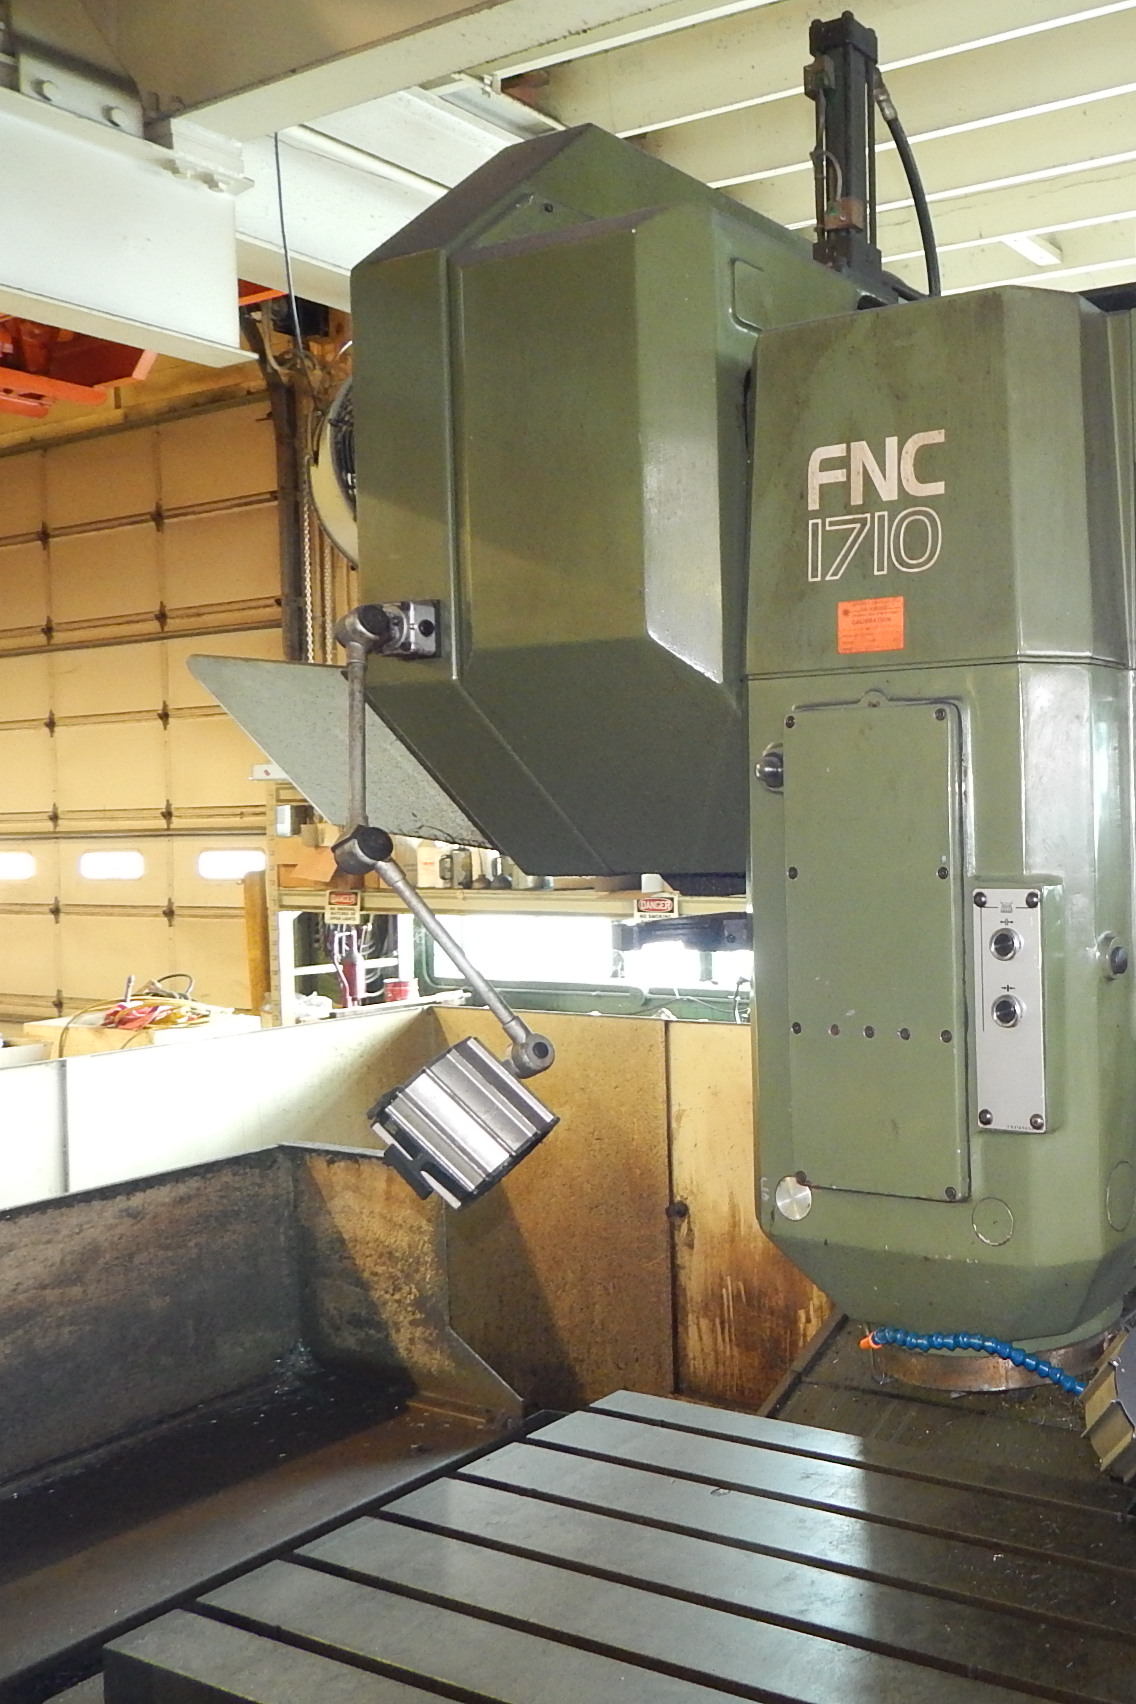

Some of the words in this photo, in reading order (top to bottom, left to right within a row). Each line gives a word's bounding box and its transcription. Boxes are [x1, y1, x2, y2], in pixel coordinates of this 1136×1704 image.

[808, 429, 946, 511] FNC
[808, 506, 943, 583] 1710
[639, 900, 672, 910] DANGER
